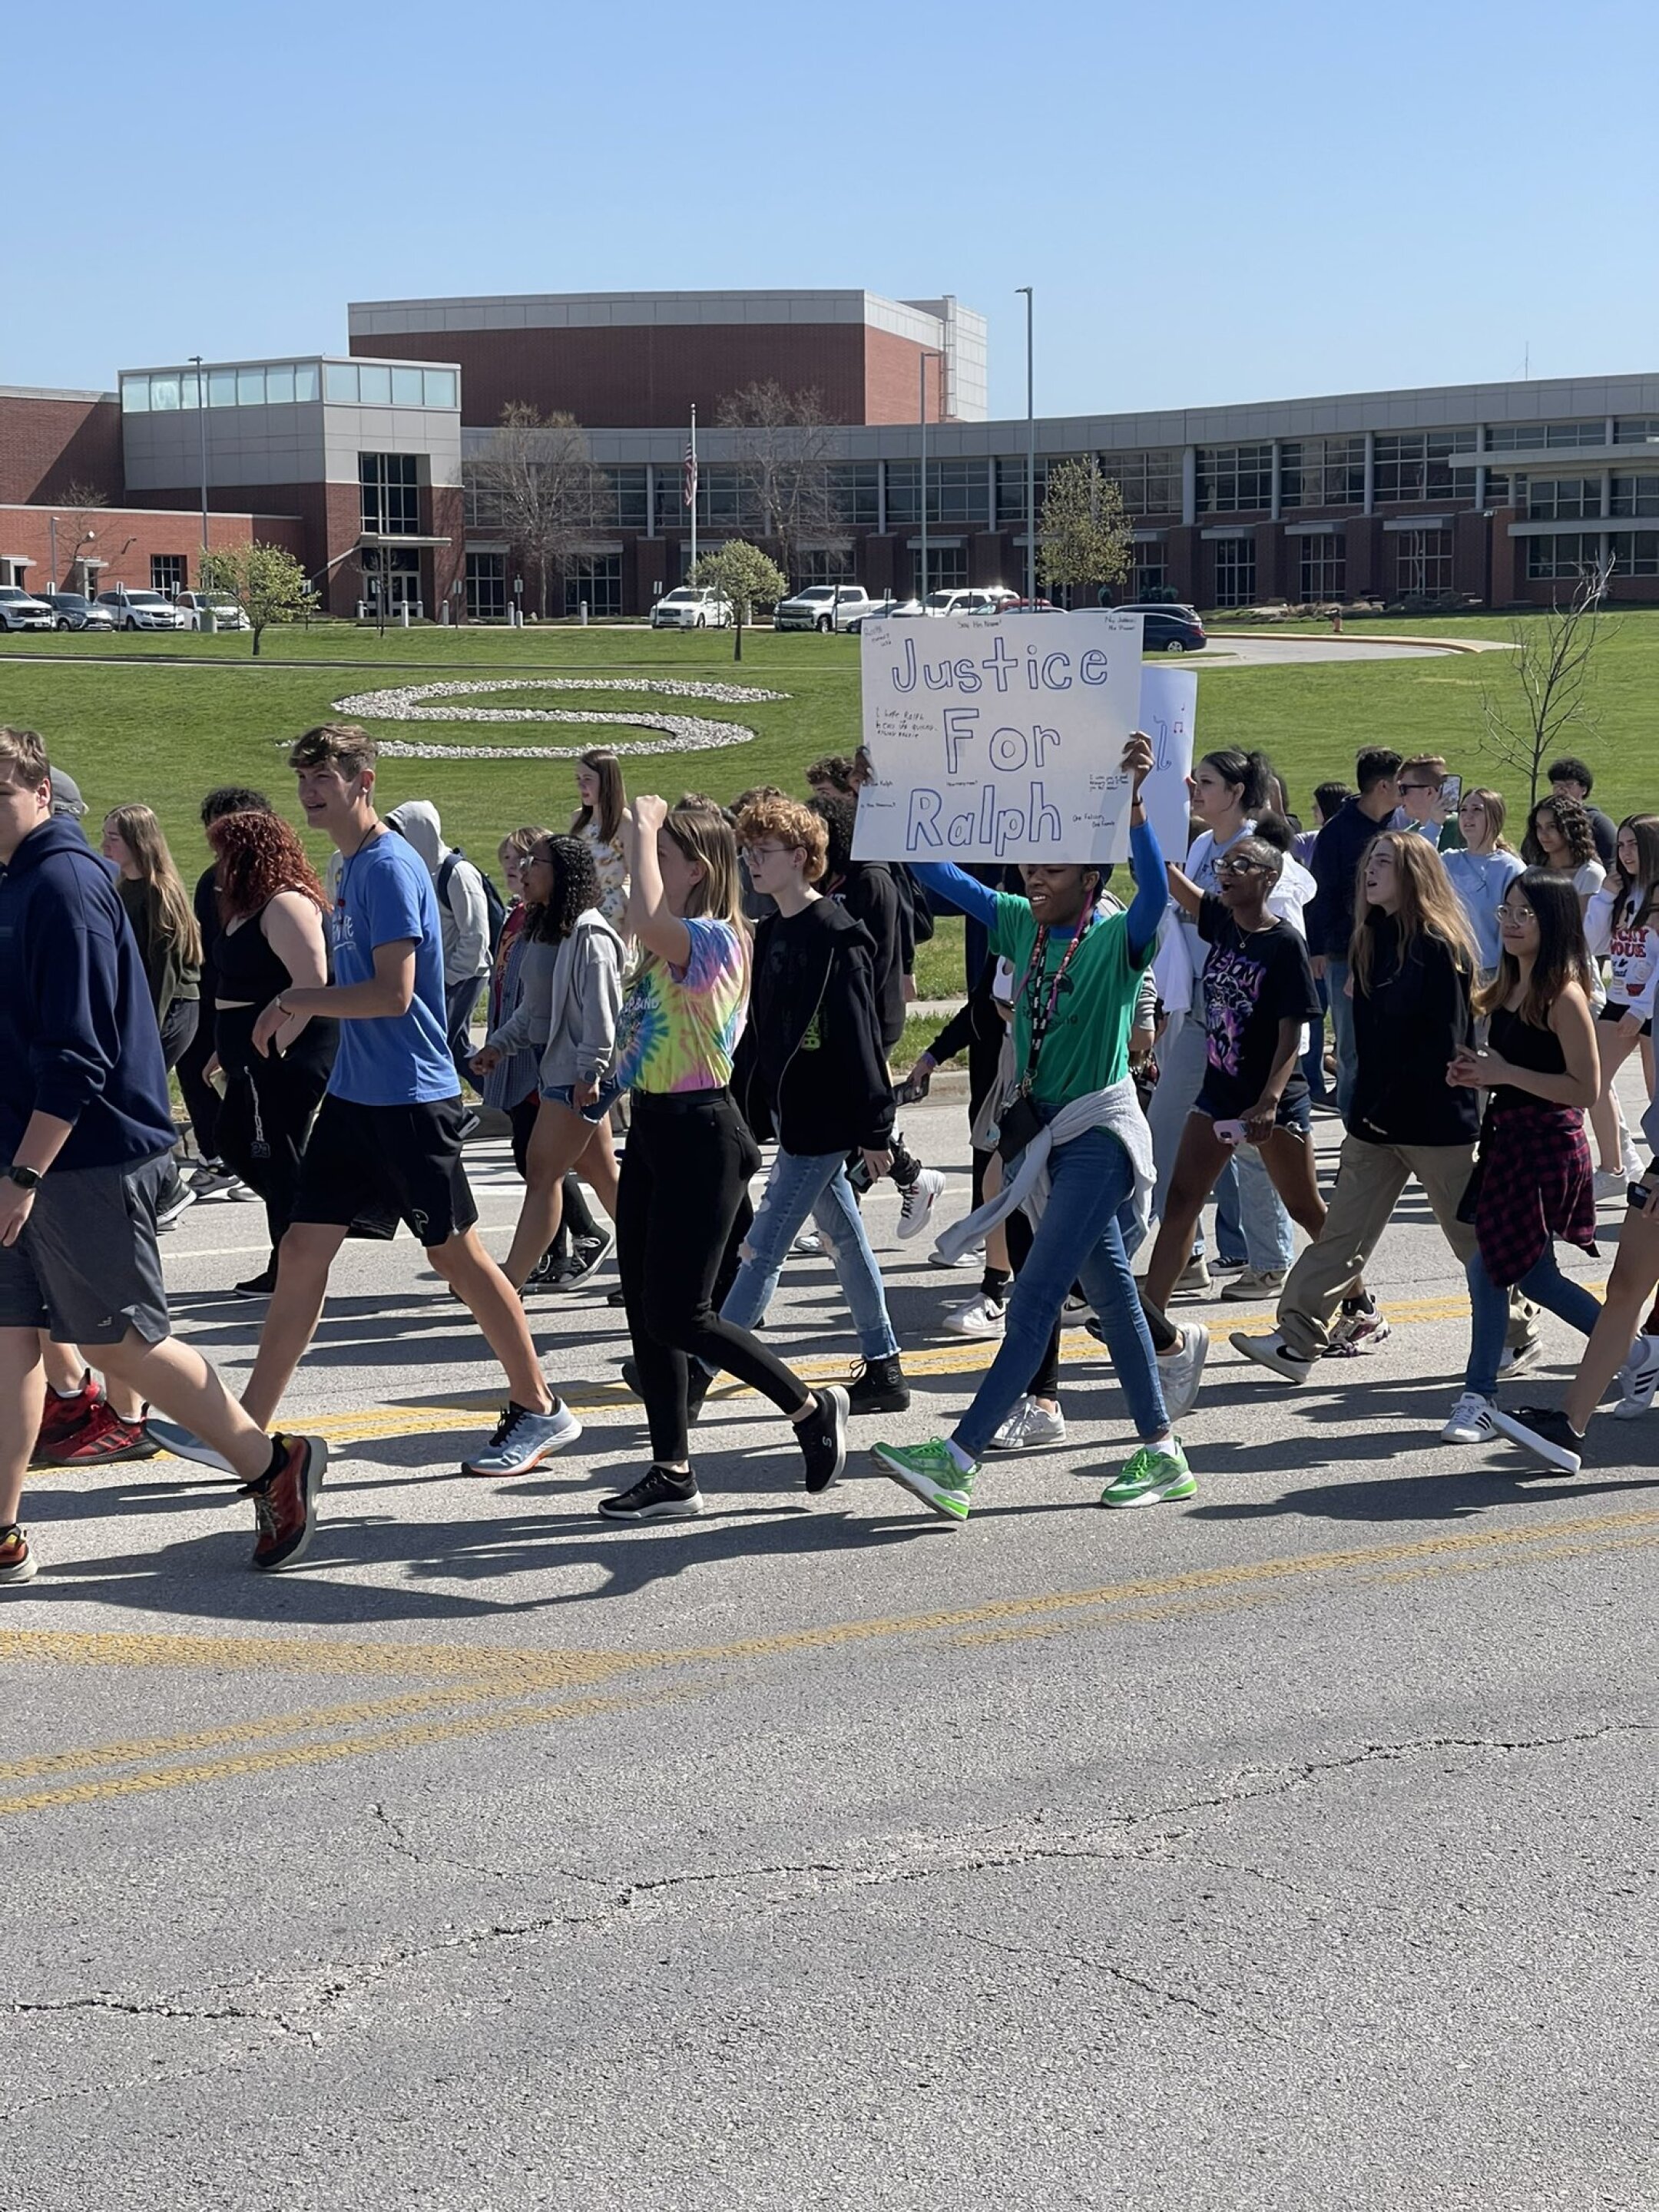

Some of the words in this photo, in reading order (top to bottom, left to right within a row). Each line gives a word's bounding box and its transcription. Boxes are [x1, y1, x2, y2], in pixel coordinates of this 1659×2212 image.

[892, 637, 1108, 693] Justice
[943, 707, 1061, 774] For
[906, 781, 1061, 856] Ralph
